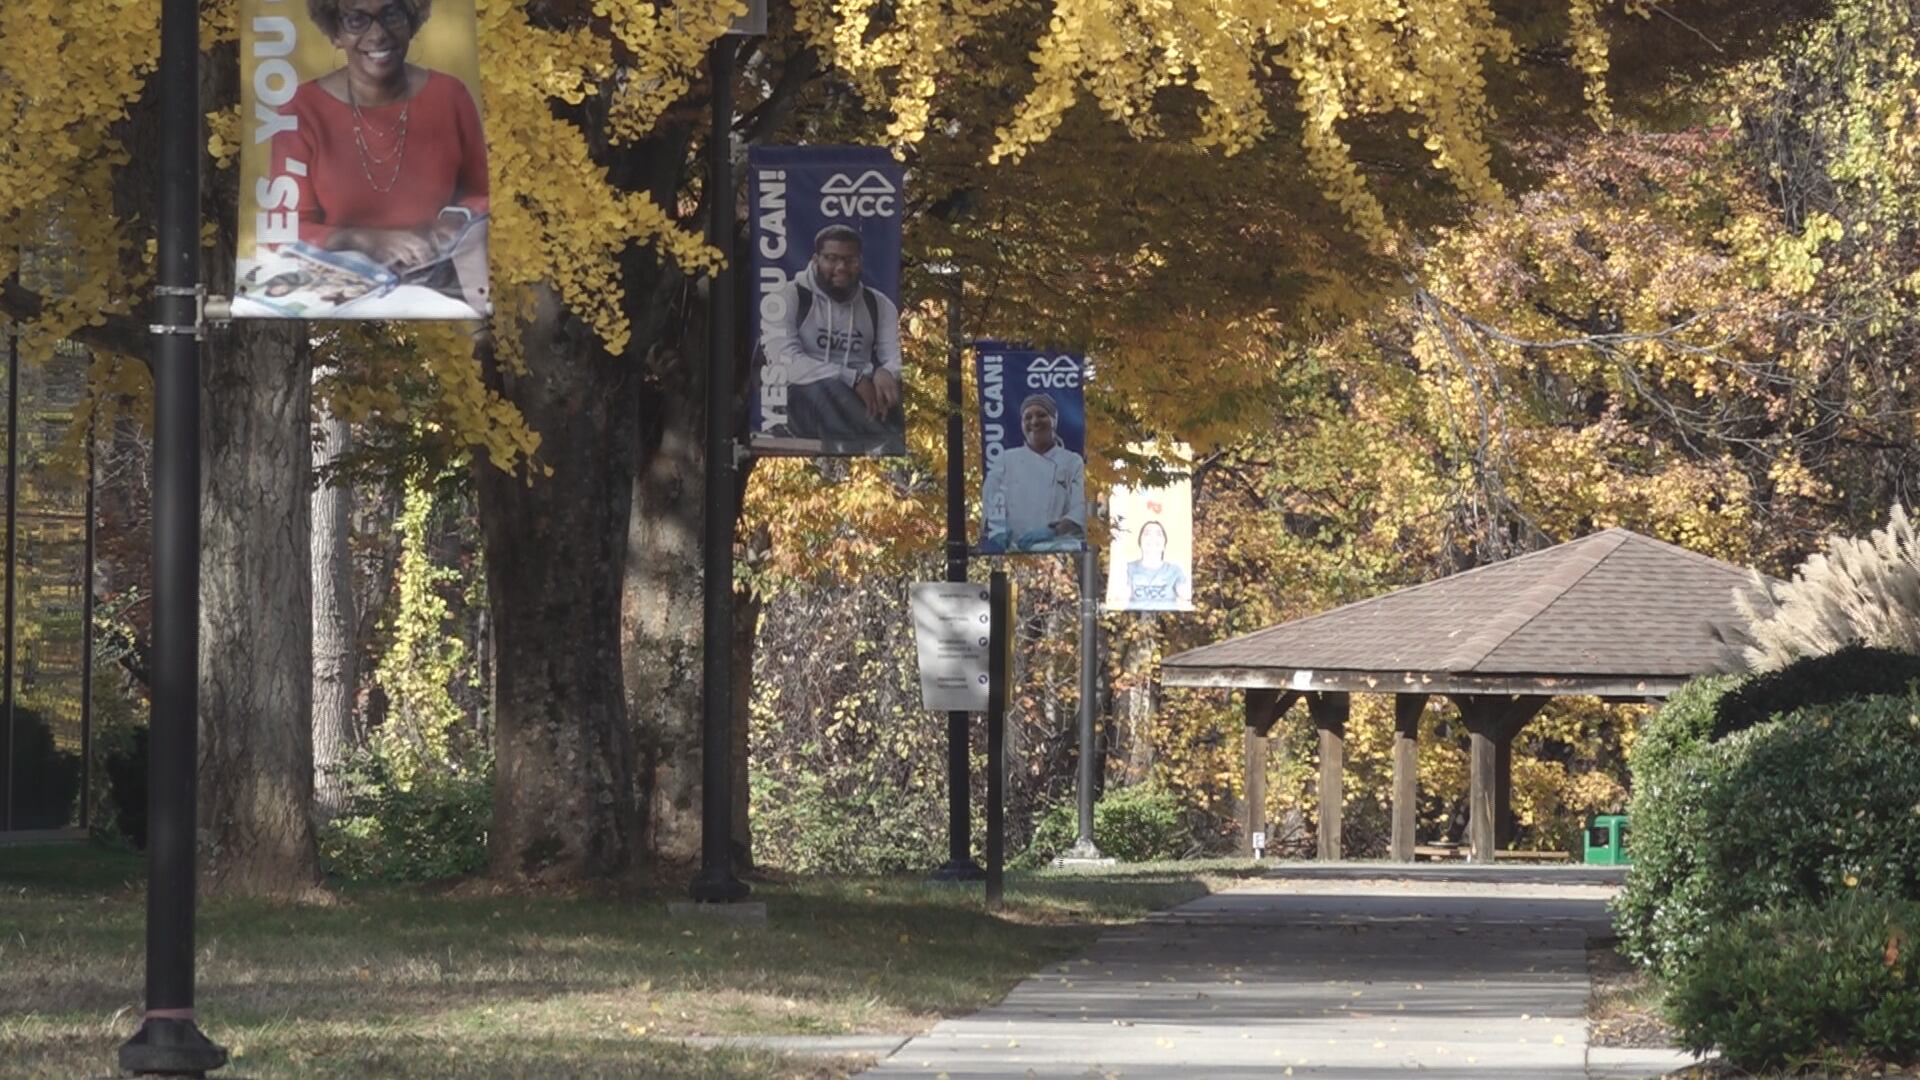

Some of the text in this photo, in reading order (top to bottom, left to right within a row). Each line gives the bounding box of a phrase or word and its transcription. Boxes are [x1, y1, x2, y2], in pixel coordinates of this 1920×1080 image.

[253, 16, 307, 286] YES, YOU
[759, 170, 787, 260] CAN!
[821, 195, 895, 217] CVCC
[760, 267, 787, 345] YOU
[816, 334, 864, 353] CVCC
[983, 355, 1005, 419] CAN!
[1027, 372, 1079, 389] CVCC
[985, 423, 1006, 479] YOU
